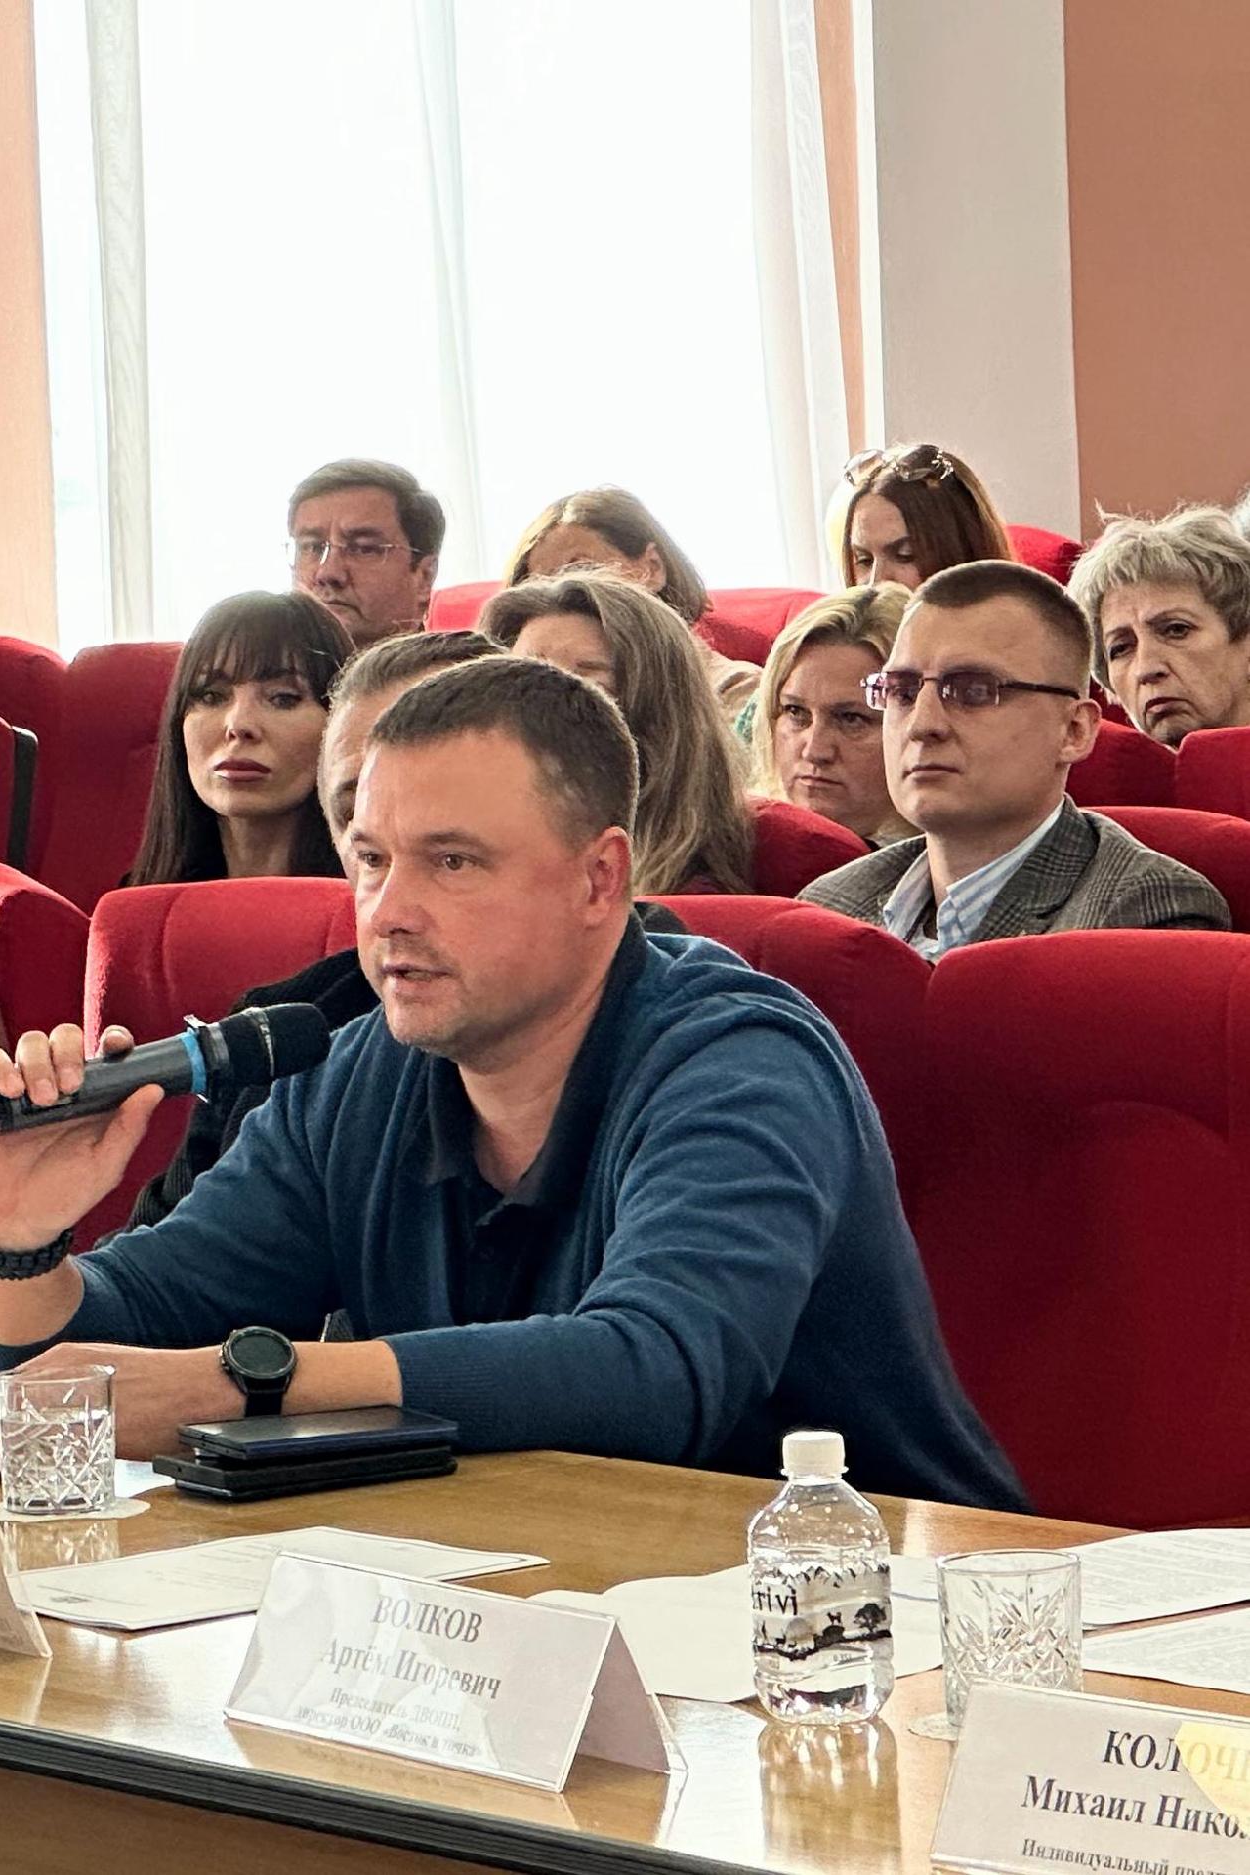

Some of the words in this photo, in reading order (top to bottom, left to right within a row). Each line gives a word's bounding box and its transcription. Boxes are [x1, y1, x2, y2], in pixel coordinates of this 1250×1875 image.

[372, 1595, 482, 1643] ВОЛКОВ
[321, 1638, 391, 1675] Артём
[394, 1649, 501, 1699] Игоревич
[1021, 1775, 1146, 1824] Михаил
